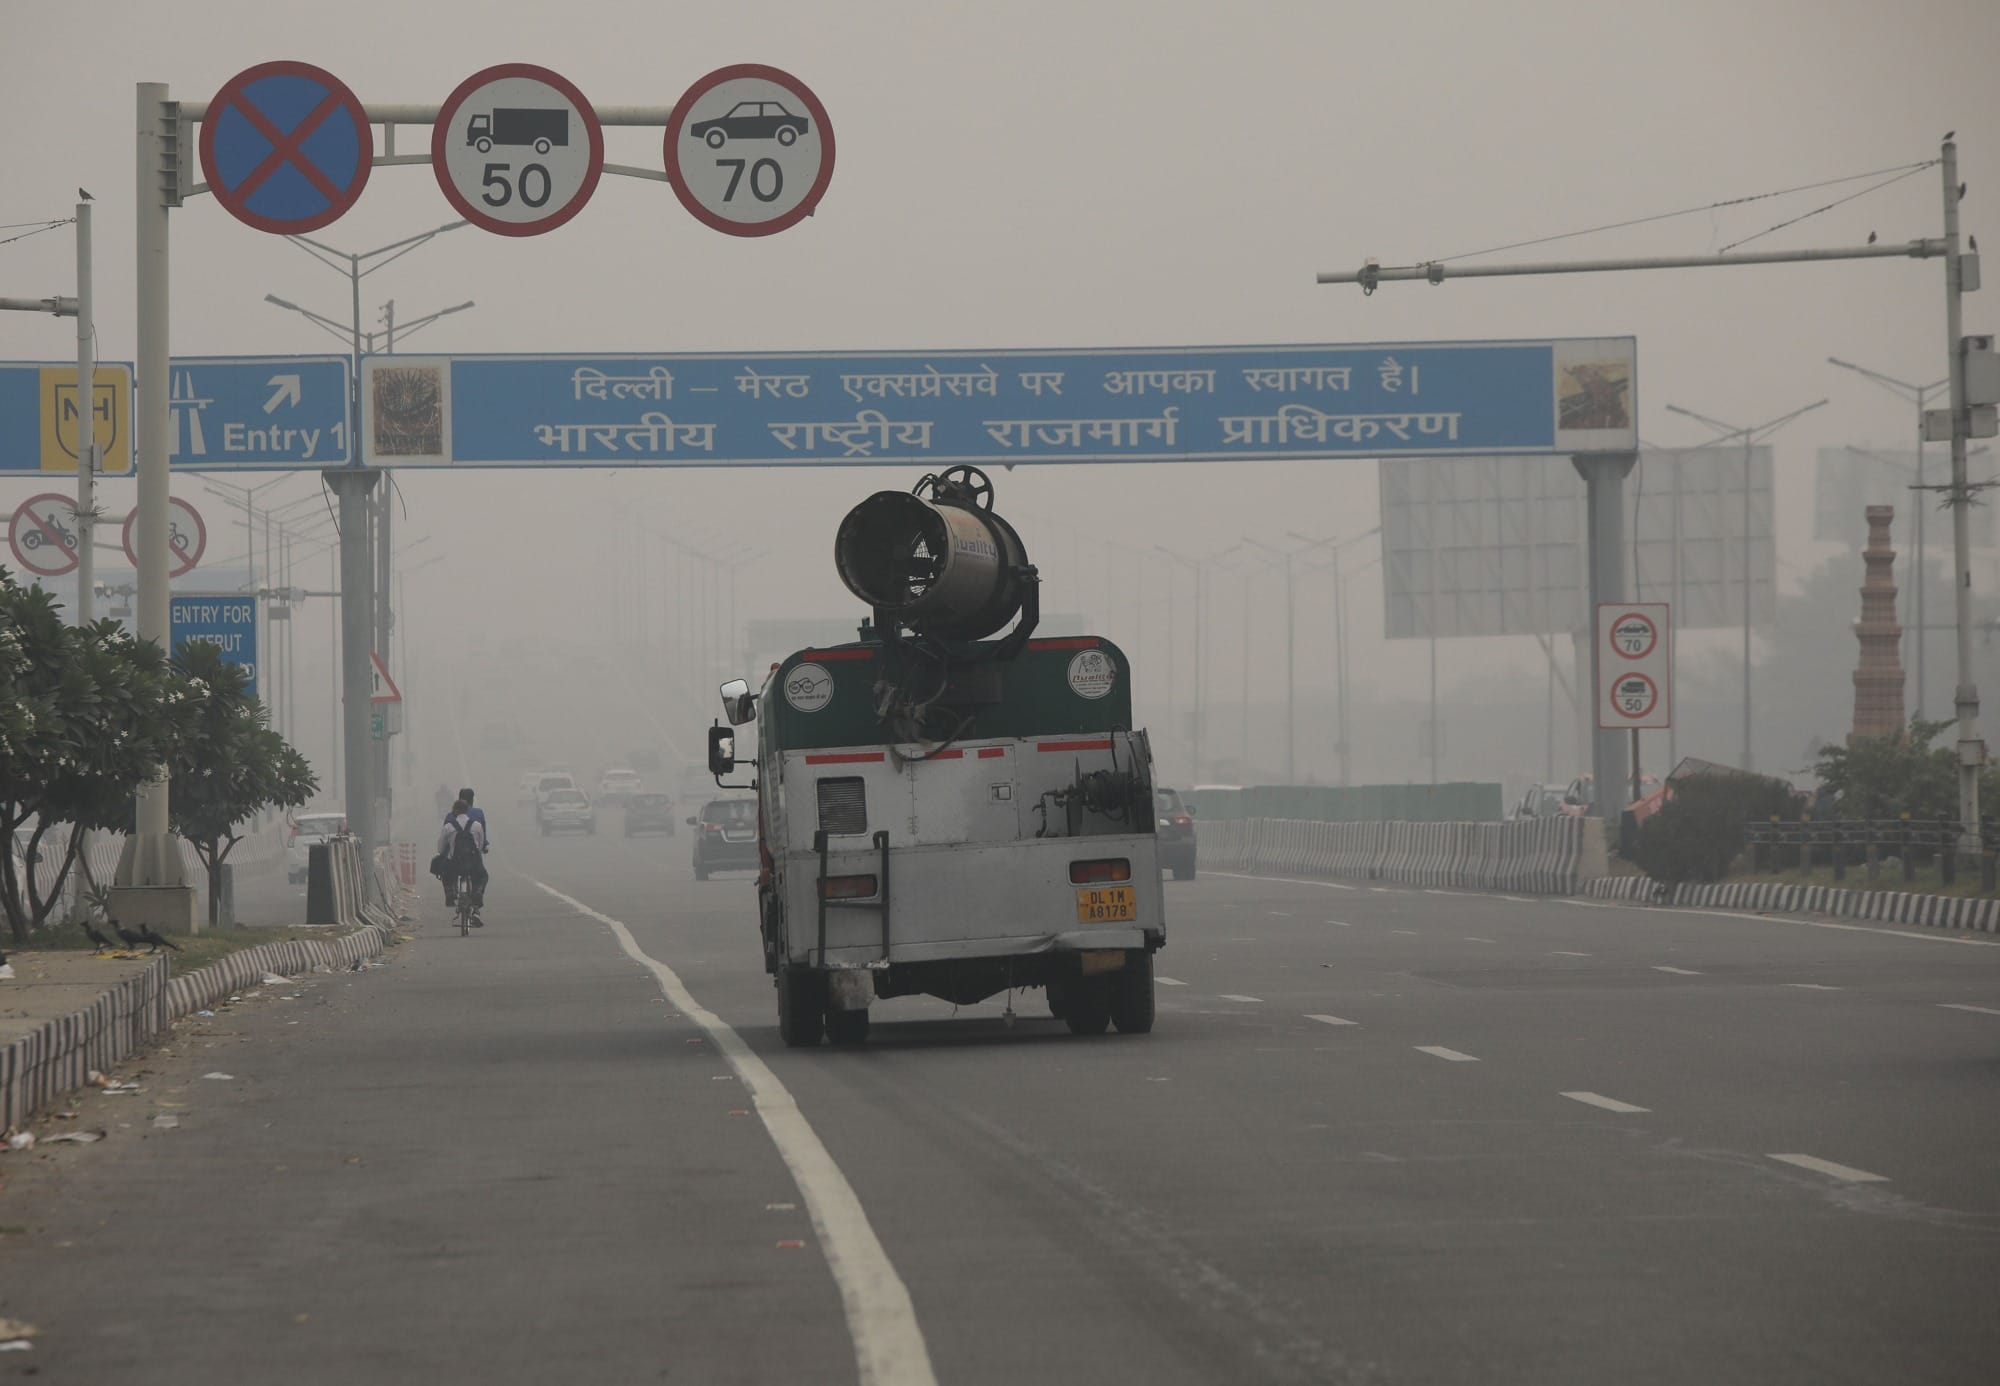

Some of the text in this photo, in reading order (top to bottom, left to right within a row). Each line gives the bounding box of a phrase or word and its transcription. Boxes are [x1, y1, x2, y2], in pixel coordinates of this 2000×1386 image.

[482, 163, 552, 208] 50
[716, 158, 783, 203] 70
[570, 366, 675, 401] दिल्ली
[734, 366, 811, 400] मेरठ
[839, 364, 1000, 403] एक्सप्रेसवे
[1018, 371, 1065, 397] पर
[1103, 369, 1217, 395] आपका
[1242, 367, 1352, 392] स्वागत
[63, 397, 109, 421] NH
[223, 421, 345, 459] Entry 1
[534, 404, 1462, 457] भारतीय राष्ट्रीय राजमार्ग प्राधिकरण
[172, 605, 252, 624] ENTRY FOR
[1625, 639, 1641, 652] 70
[1625, 699, 1642, 711] 50
[1090, 891, 1105, 905] DL
